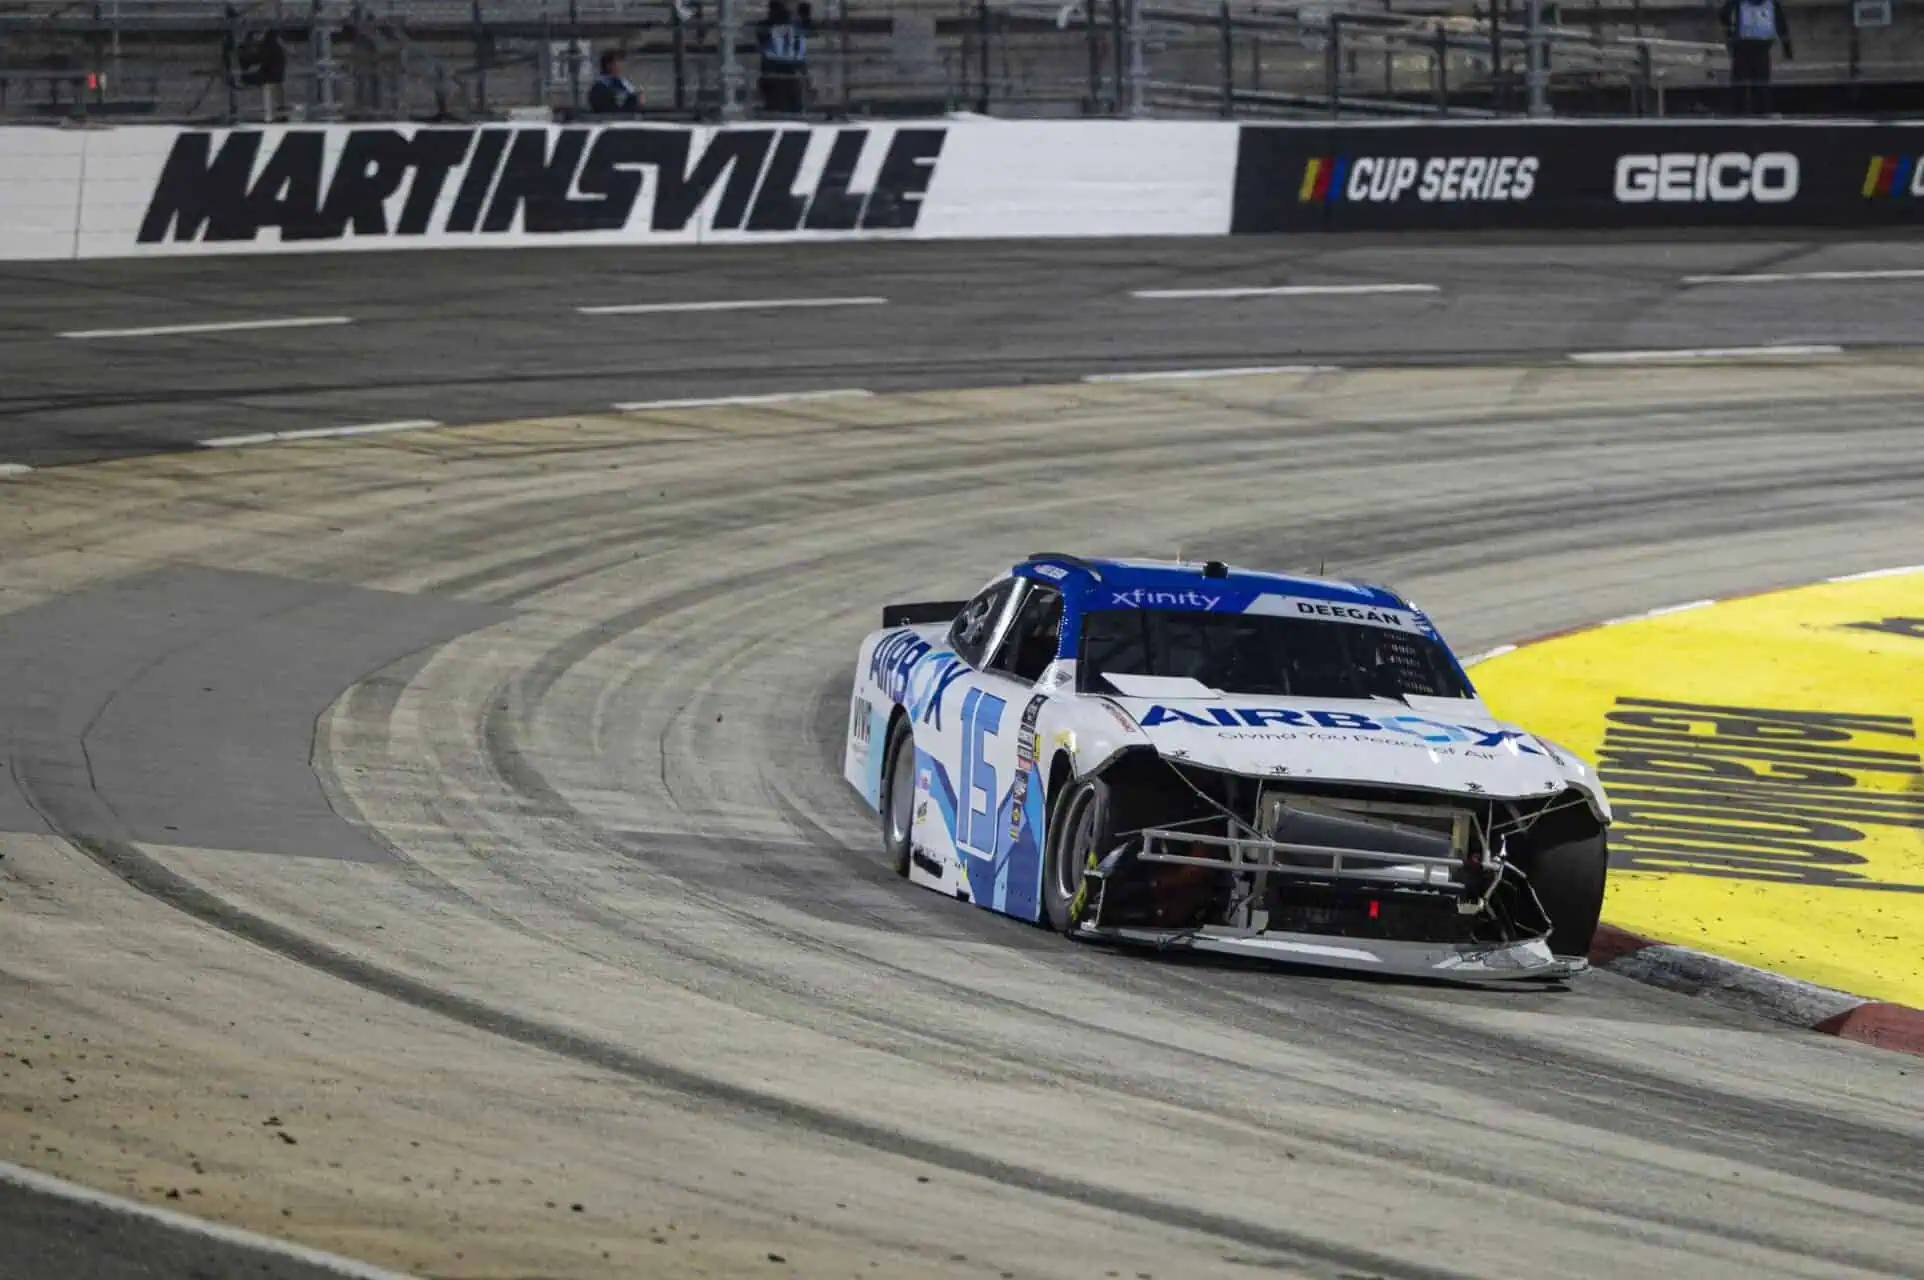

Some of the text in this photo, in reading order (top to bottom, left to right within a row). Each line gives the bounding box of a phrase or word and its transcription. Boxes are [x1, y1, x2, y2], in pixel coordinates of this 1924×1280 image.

[136, 128, 947, 244] MARTINSVILLE
[1347, 156, 1540, 202] CUP SERIES
[1614, 152, 1800, 203] GEICO
[1111, 588, 1221, 612] xfinity
[1297, 602, 1402, 626] DEEGAN
